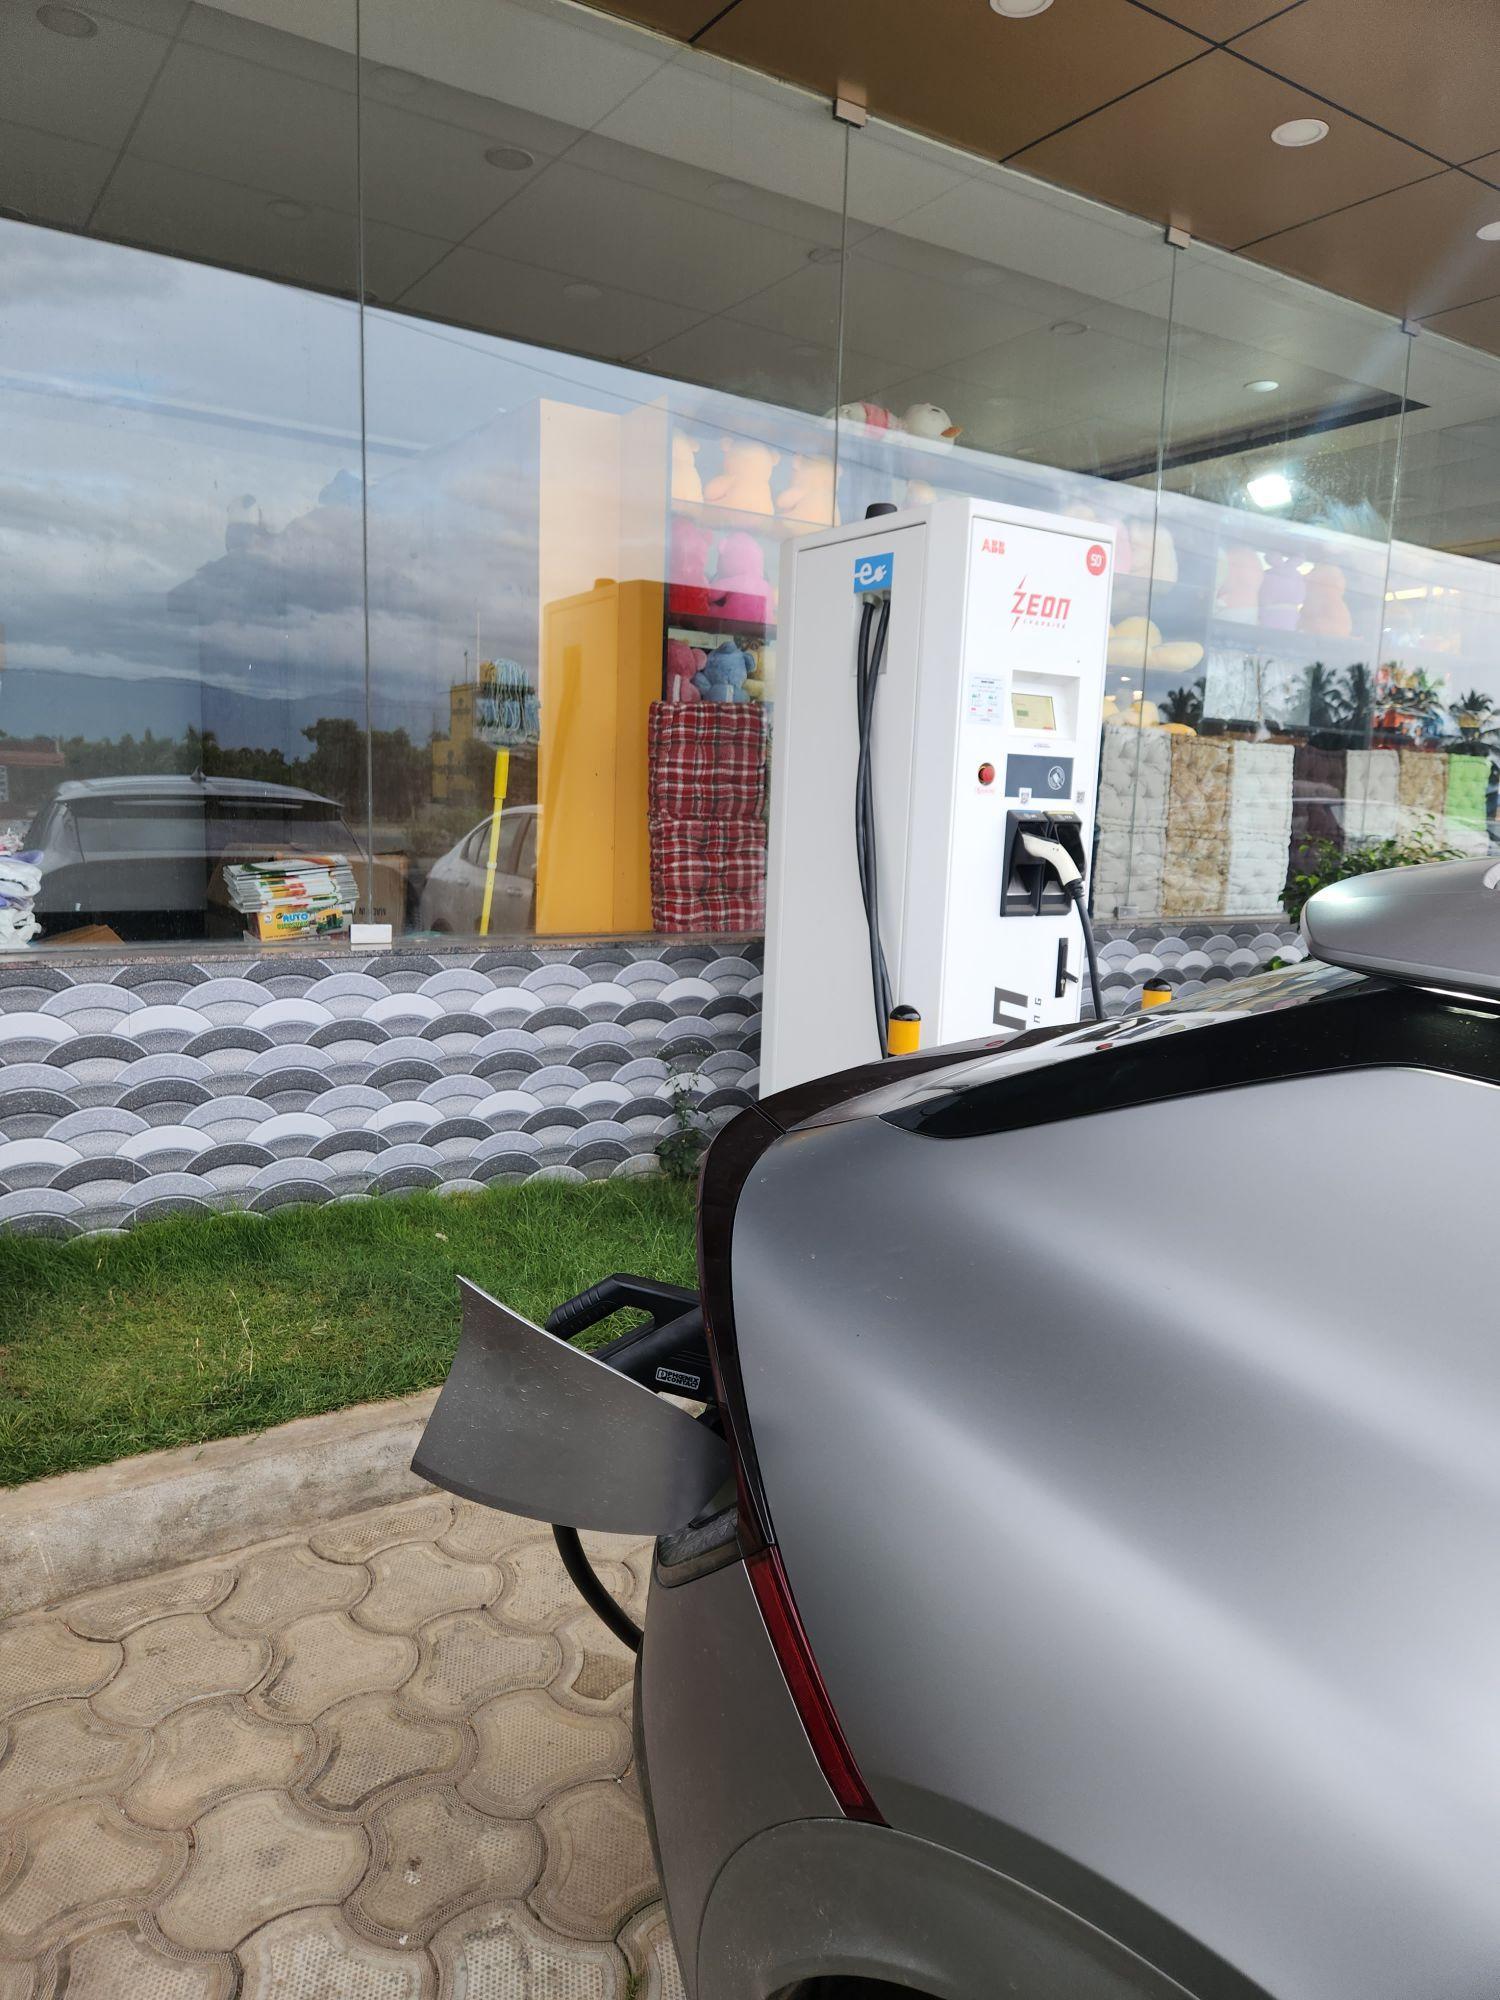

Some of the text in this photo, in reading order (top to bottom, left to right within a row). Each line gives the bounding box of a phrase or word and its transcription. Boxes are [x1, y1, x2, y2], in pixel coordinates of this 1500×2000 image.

[981, 537, 1006, 555] ABB
[1011, 590, 1072, 621] ZEON
[282, 911, 309, 922] AUTO
